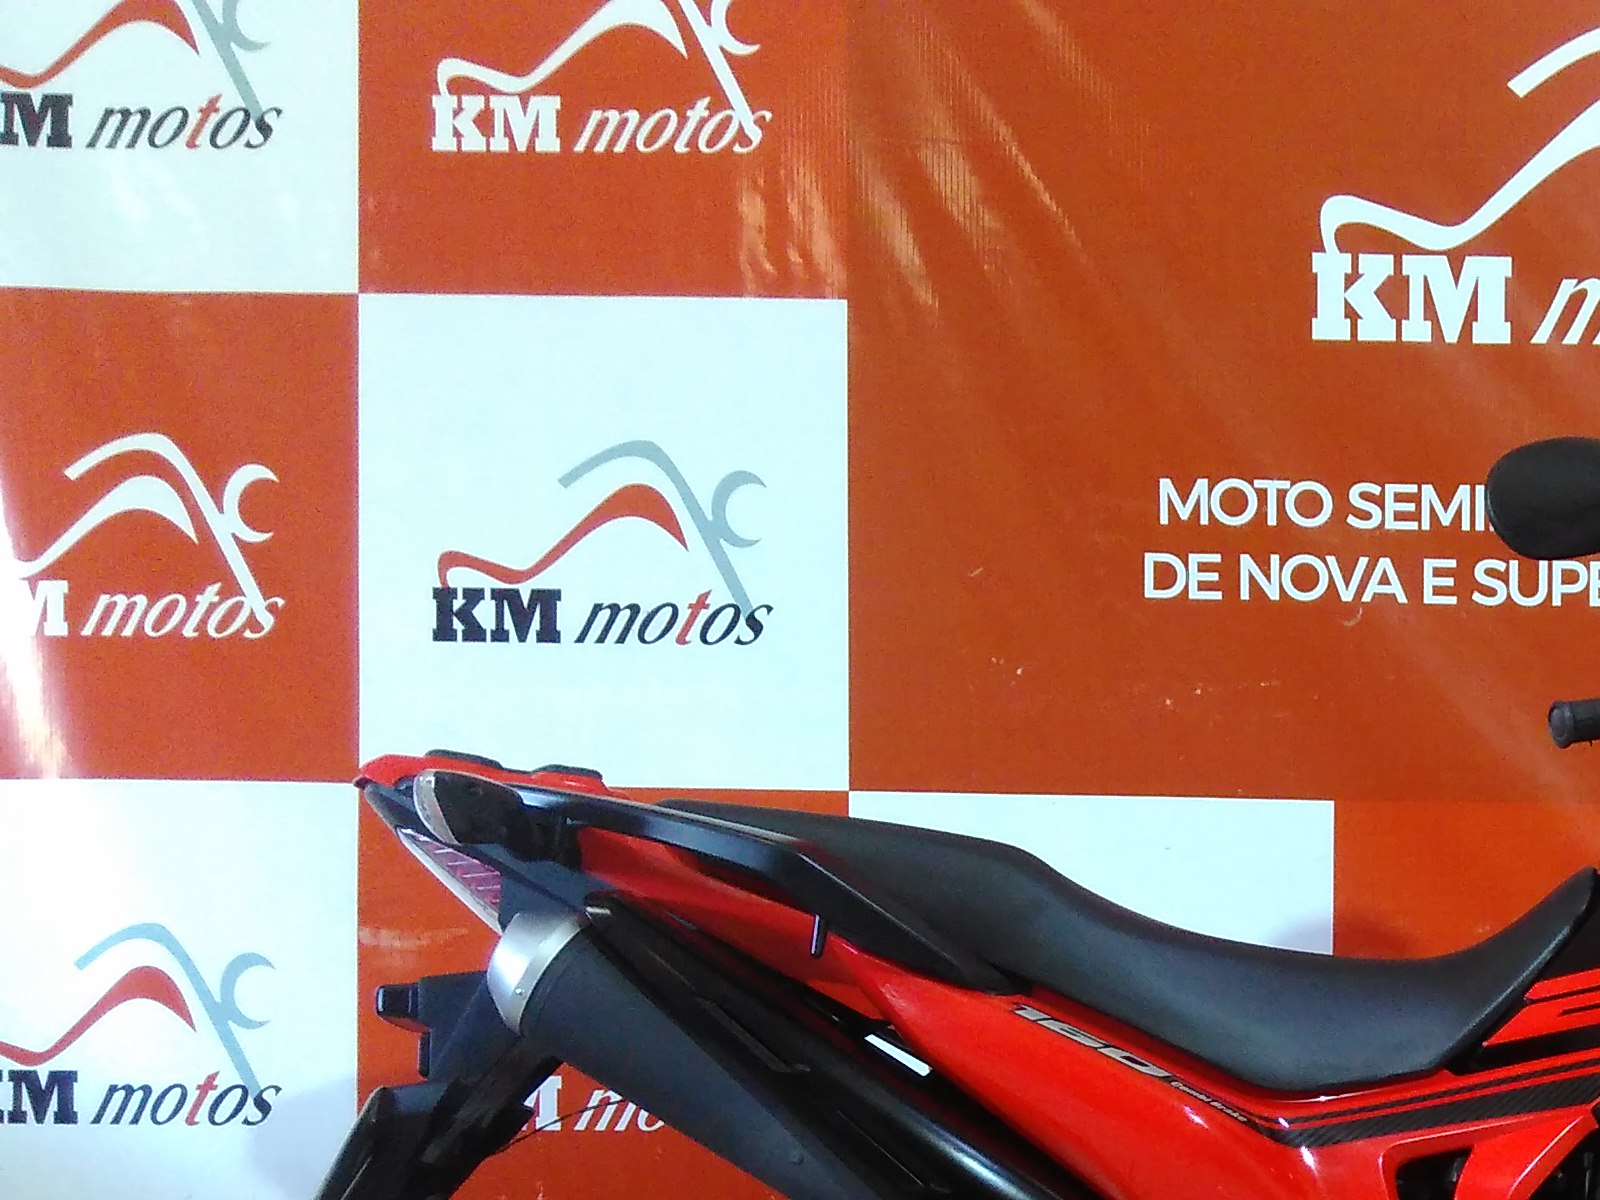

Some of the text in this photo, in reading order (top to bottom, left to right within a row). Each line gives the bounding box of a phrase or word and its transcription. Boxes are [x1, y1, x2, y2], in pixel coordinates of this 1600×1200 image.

[0, 90, 283, 149] M motos
[432, 95, 773, 154] KM motos
[1311, 252, 1513, 344] KM
[1158, 478, 1333, 528] MOTO
[1143, 552, 1223, 601] DE
[1239, 554, 1408, 605] NOVA
[1423, 558, 1458, 605] E
[80, 582, 285, 639] motos
[432, 587, 774, 645] KM motos
[1012, 1001, 1172, 1078] 160
[0, 1069, 283, 1126] M motos
